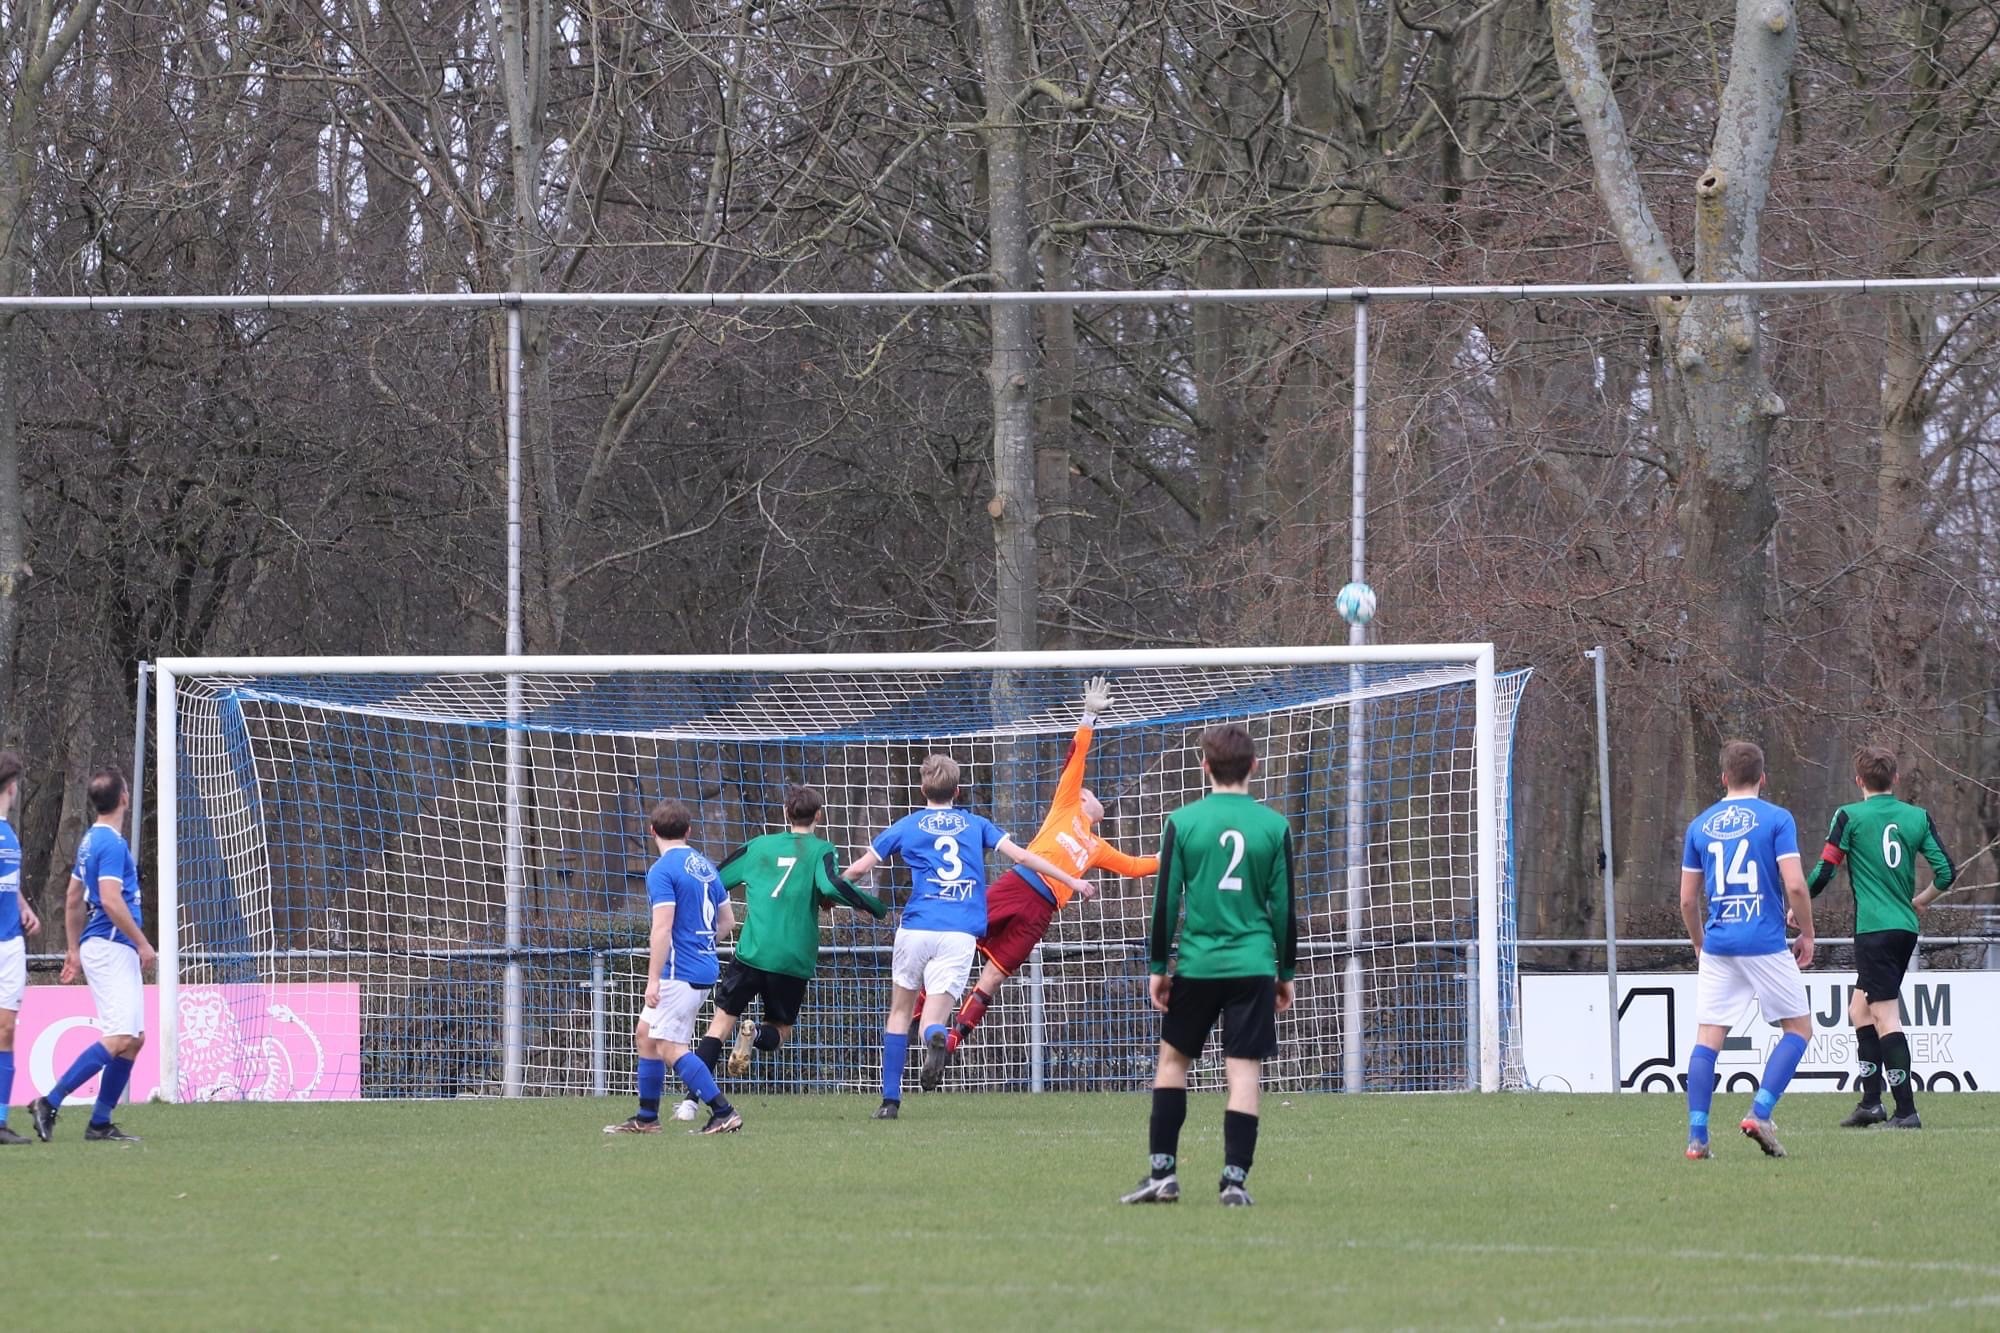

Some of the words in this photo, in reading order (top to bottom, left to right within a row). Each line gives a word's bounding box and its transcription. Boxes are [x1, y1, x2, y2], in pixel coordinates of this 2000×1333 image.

[918, 815, 969, 830] KEPPEL
[1702, 813, 1759, 833] KEPPEL
[934, 835, 963, 881] 3
[1218, 829, 1245, 891] 2
[1707, 839, 1758, 895] 14
[1882, 823, 1902, 869] 6
[771, 857, 797, 898] 7
